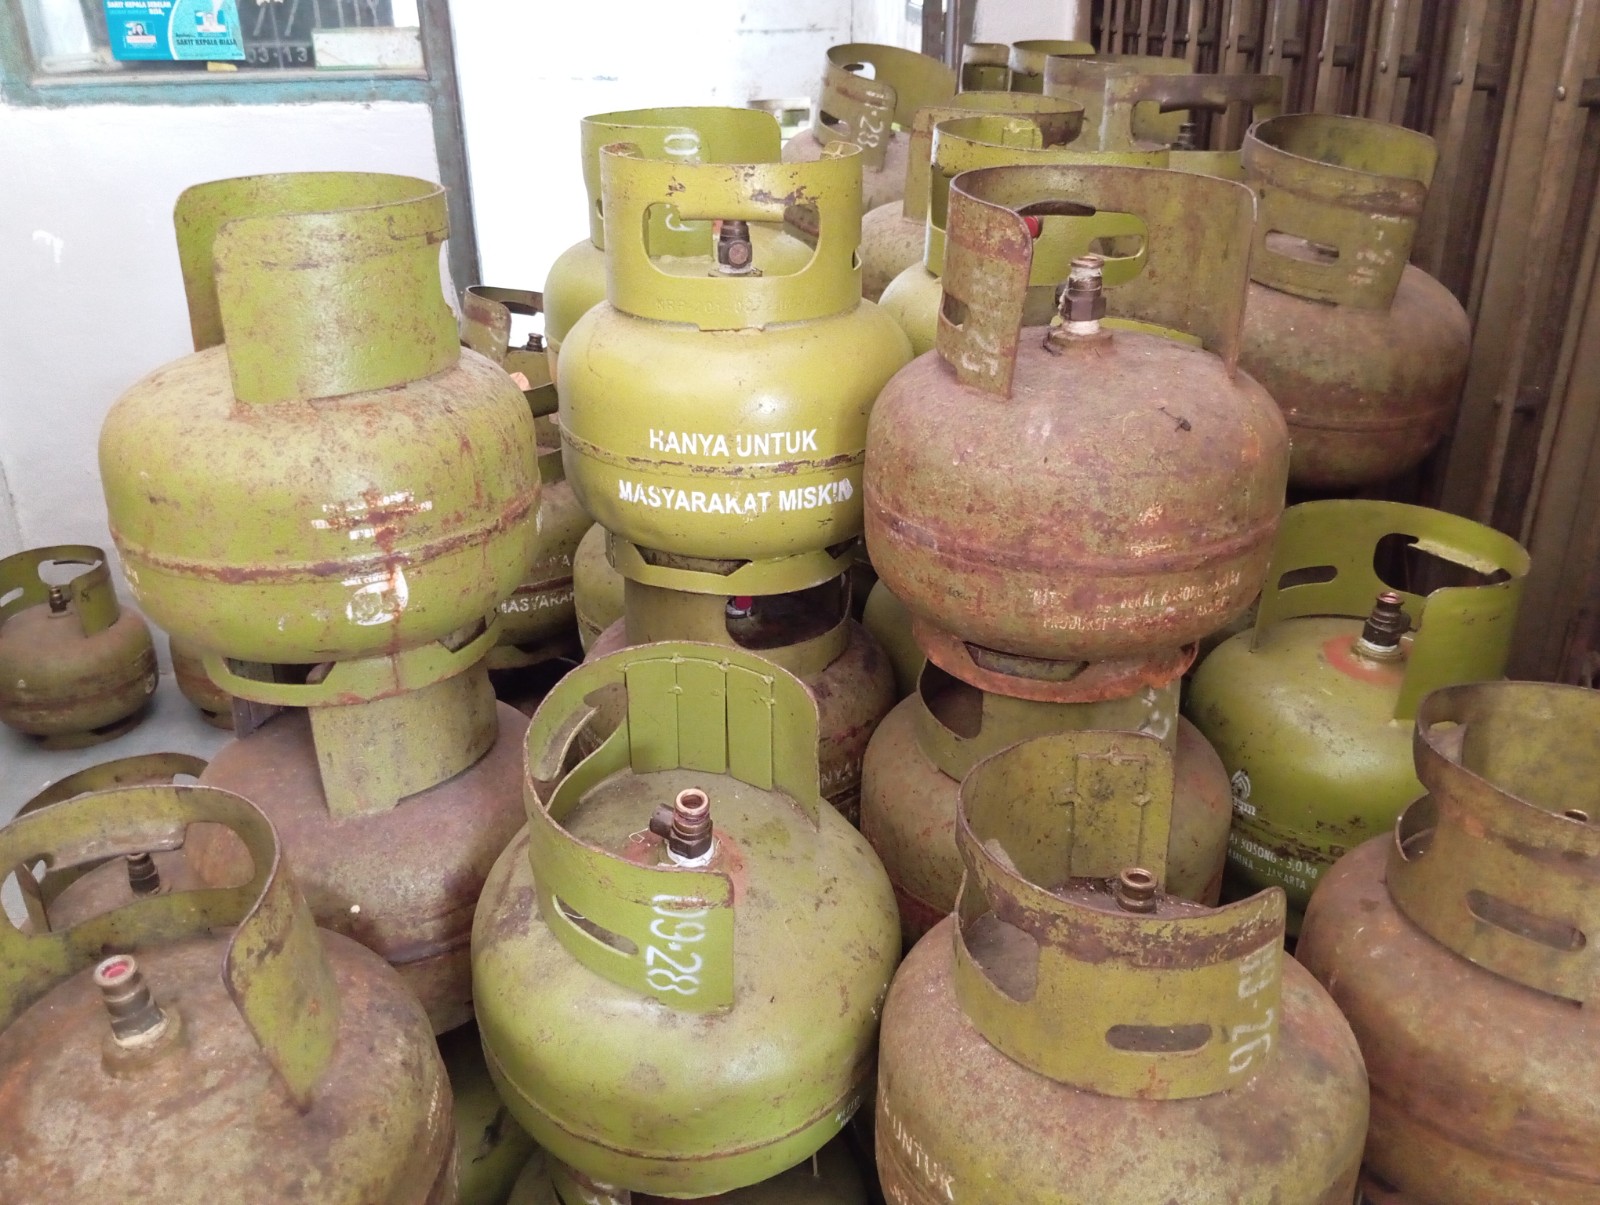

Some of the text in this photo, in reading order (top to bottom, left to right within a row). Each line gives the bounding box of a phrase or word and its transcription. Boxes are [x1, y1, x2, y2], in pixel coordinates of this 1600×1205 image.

[649, 428, 818, 457] HANYA UNTUK
[618, 479, 771, 515] MASYARAKAT
